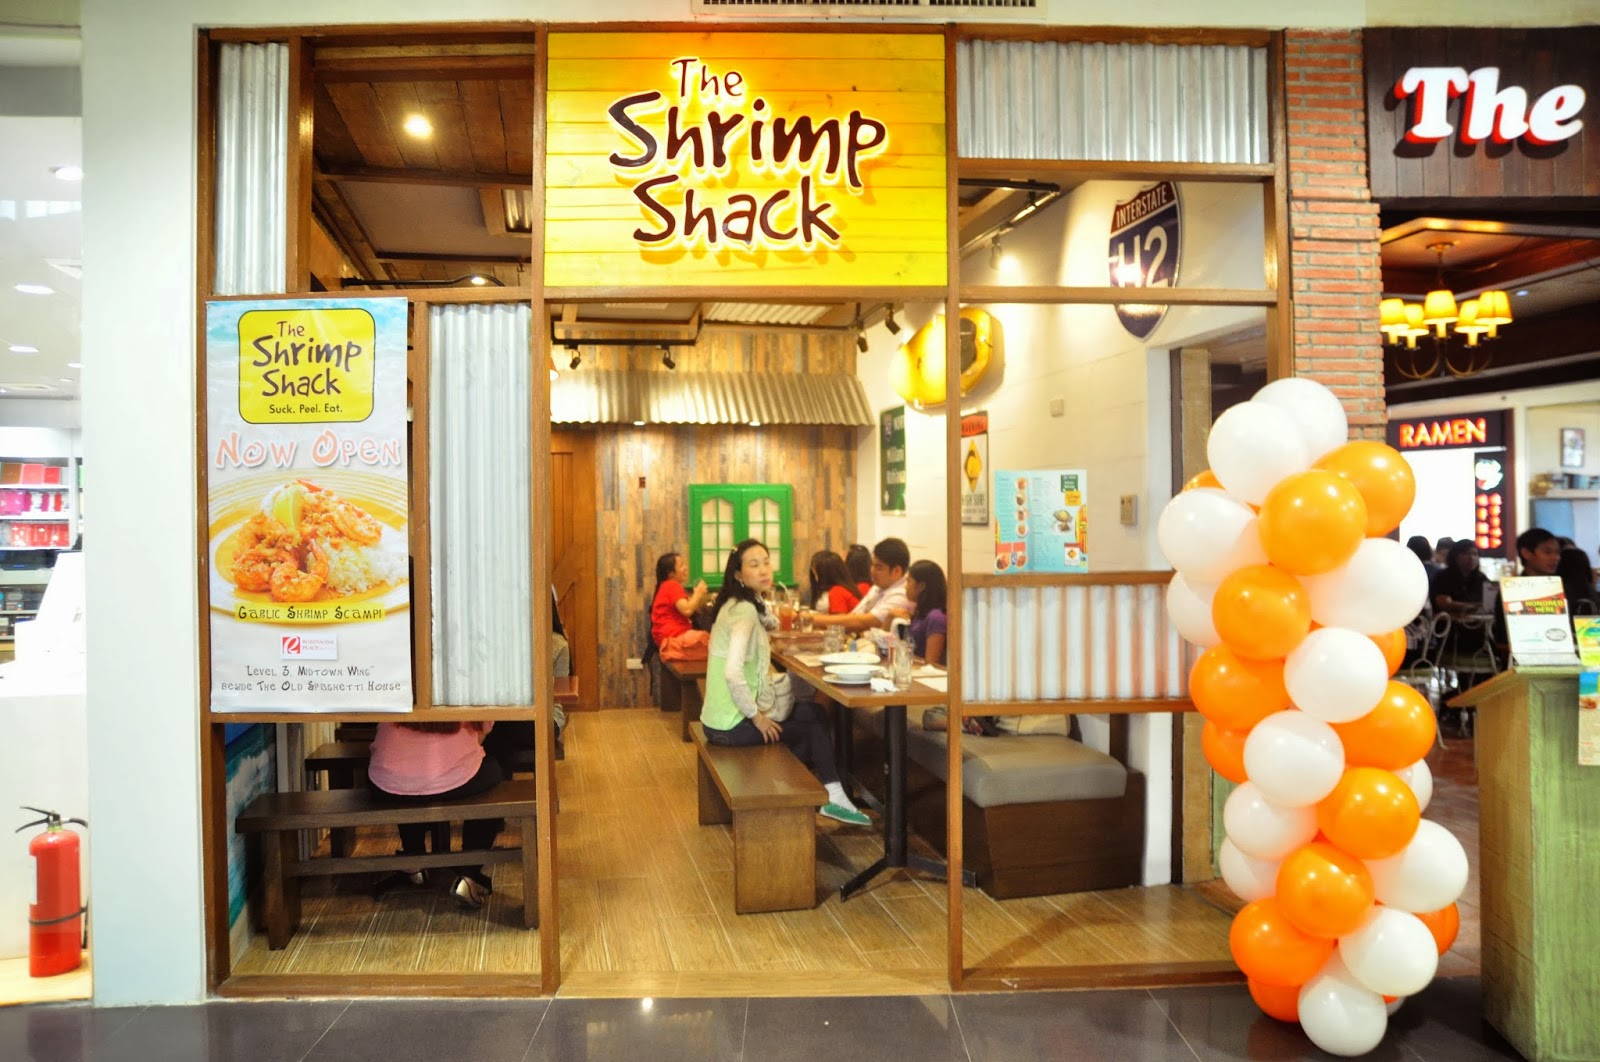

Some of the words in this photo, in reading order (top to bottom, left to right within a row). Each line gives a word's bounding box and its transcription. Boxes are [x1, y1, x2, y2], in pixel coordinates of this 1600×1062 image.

[672, 58, 743, 97] The
[1395, 66, 1586, 145] The
[608, 91, 886, 188] Shrimp
[633, 174, 840, 245] Shack
[1116, 184, 1167, 228] INTERSTATE
[277, 321, 305, 337] The
[252, 335, 362, 372] Shrimp
[262, 368, 341, 396] Shack
[269, 404, 295, 414] Suck.
[299, 403, 321, 413] Peel.
[324, 403, 343, 413] Eat.
[1399, 418, 1487, 447] RAMEN
[1525, 599, 1564, 608] HONORED
